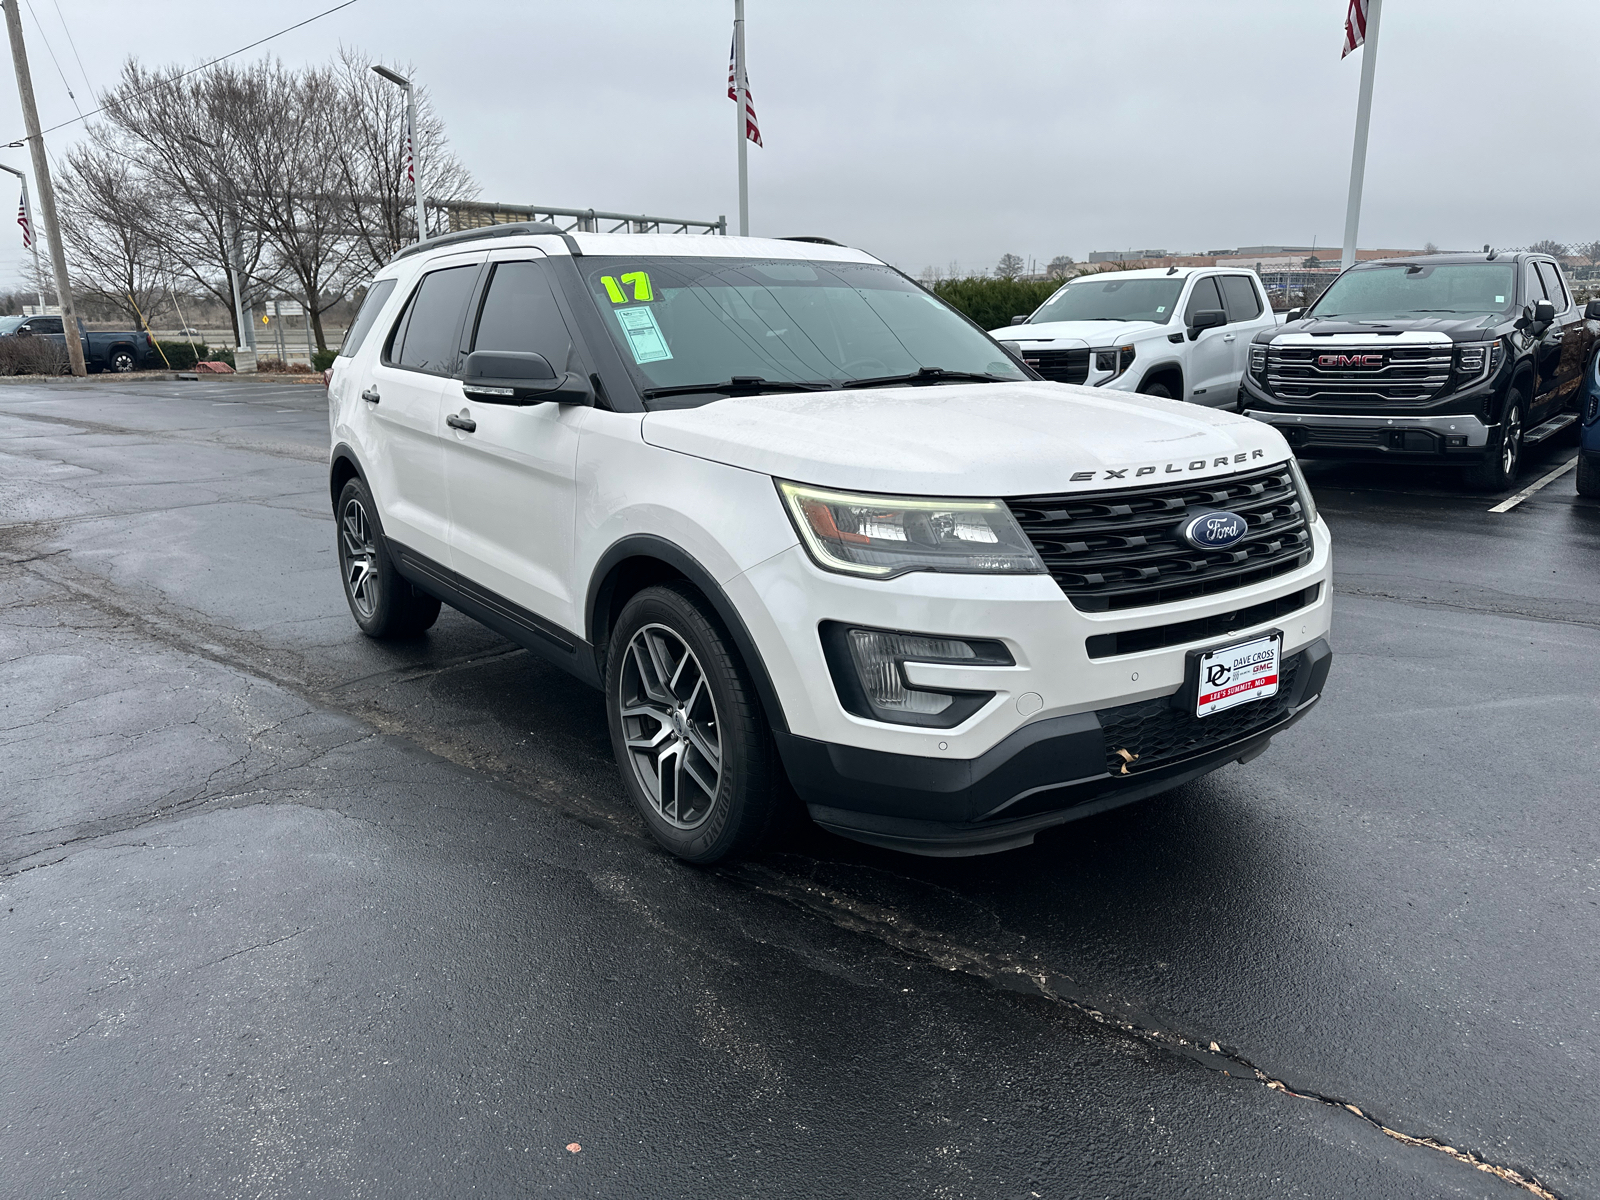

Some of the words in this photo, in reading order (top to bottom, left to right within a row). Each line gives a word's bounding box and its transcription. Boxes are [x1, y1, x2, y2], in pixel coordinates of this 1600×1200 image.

[601, 271, 653, 303] 17
[1318, 354, 1383, 367] GMC
[1069, 449, 1264, 482] EXPLORER
[1206, 517, 1240, 541] Ford
[1234, 655, 1251, 667] DAVE
[1253, 649, 1274, 661] CROSS
[1253, 662, 1273, 672] GMC
[1205, 664, 1231, 686] DC
[1210, 691, 1226, 700] LEE'S
[1227, 682, 1252, 695] SUMMIT,
[702, 760, 732, 849] ASSURANCE
